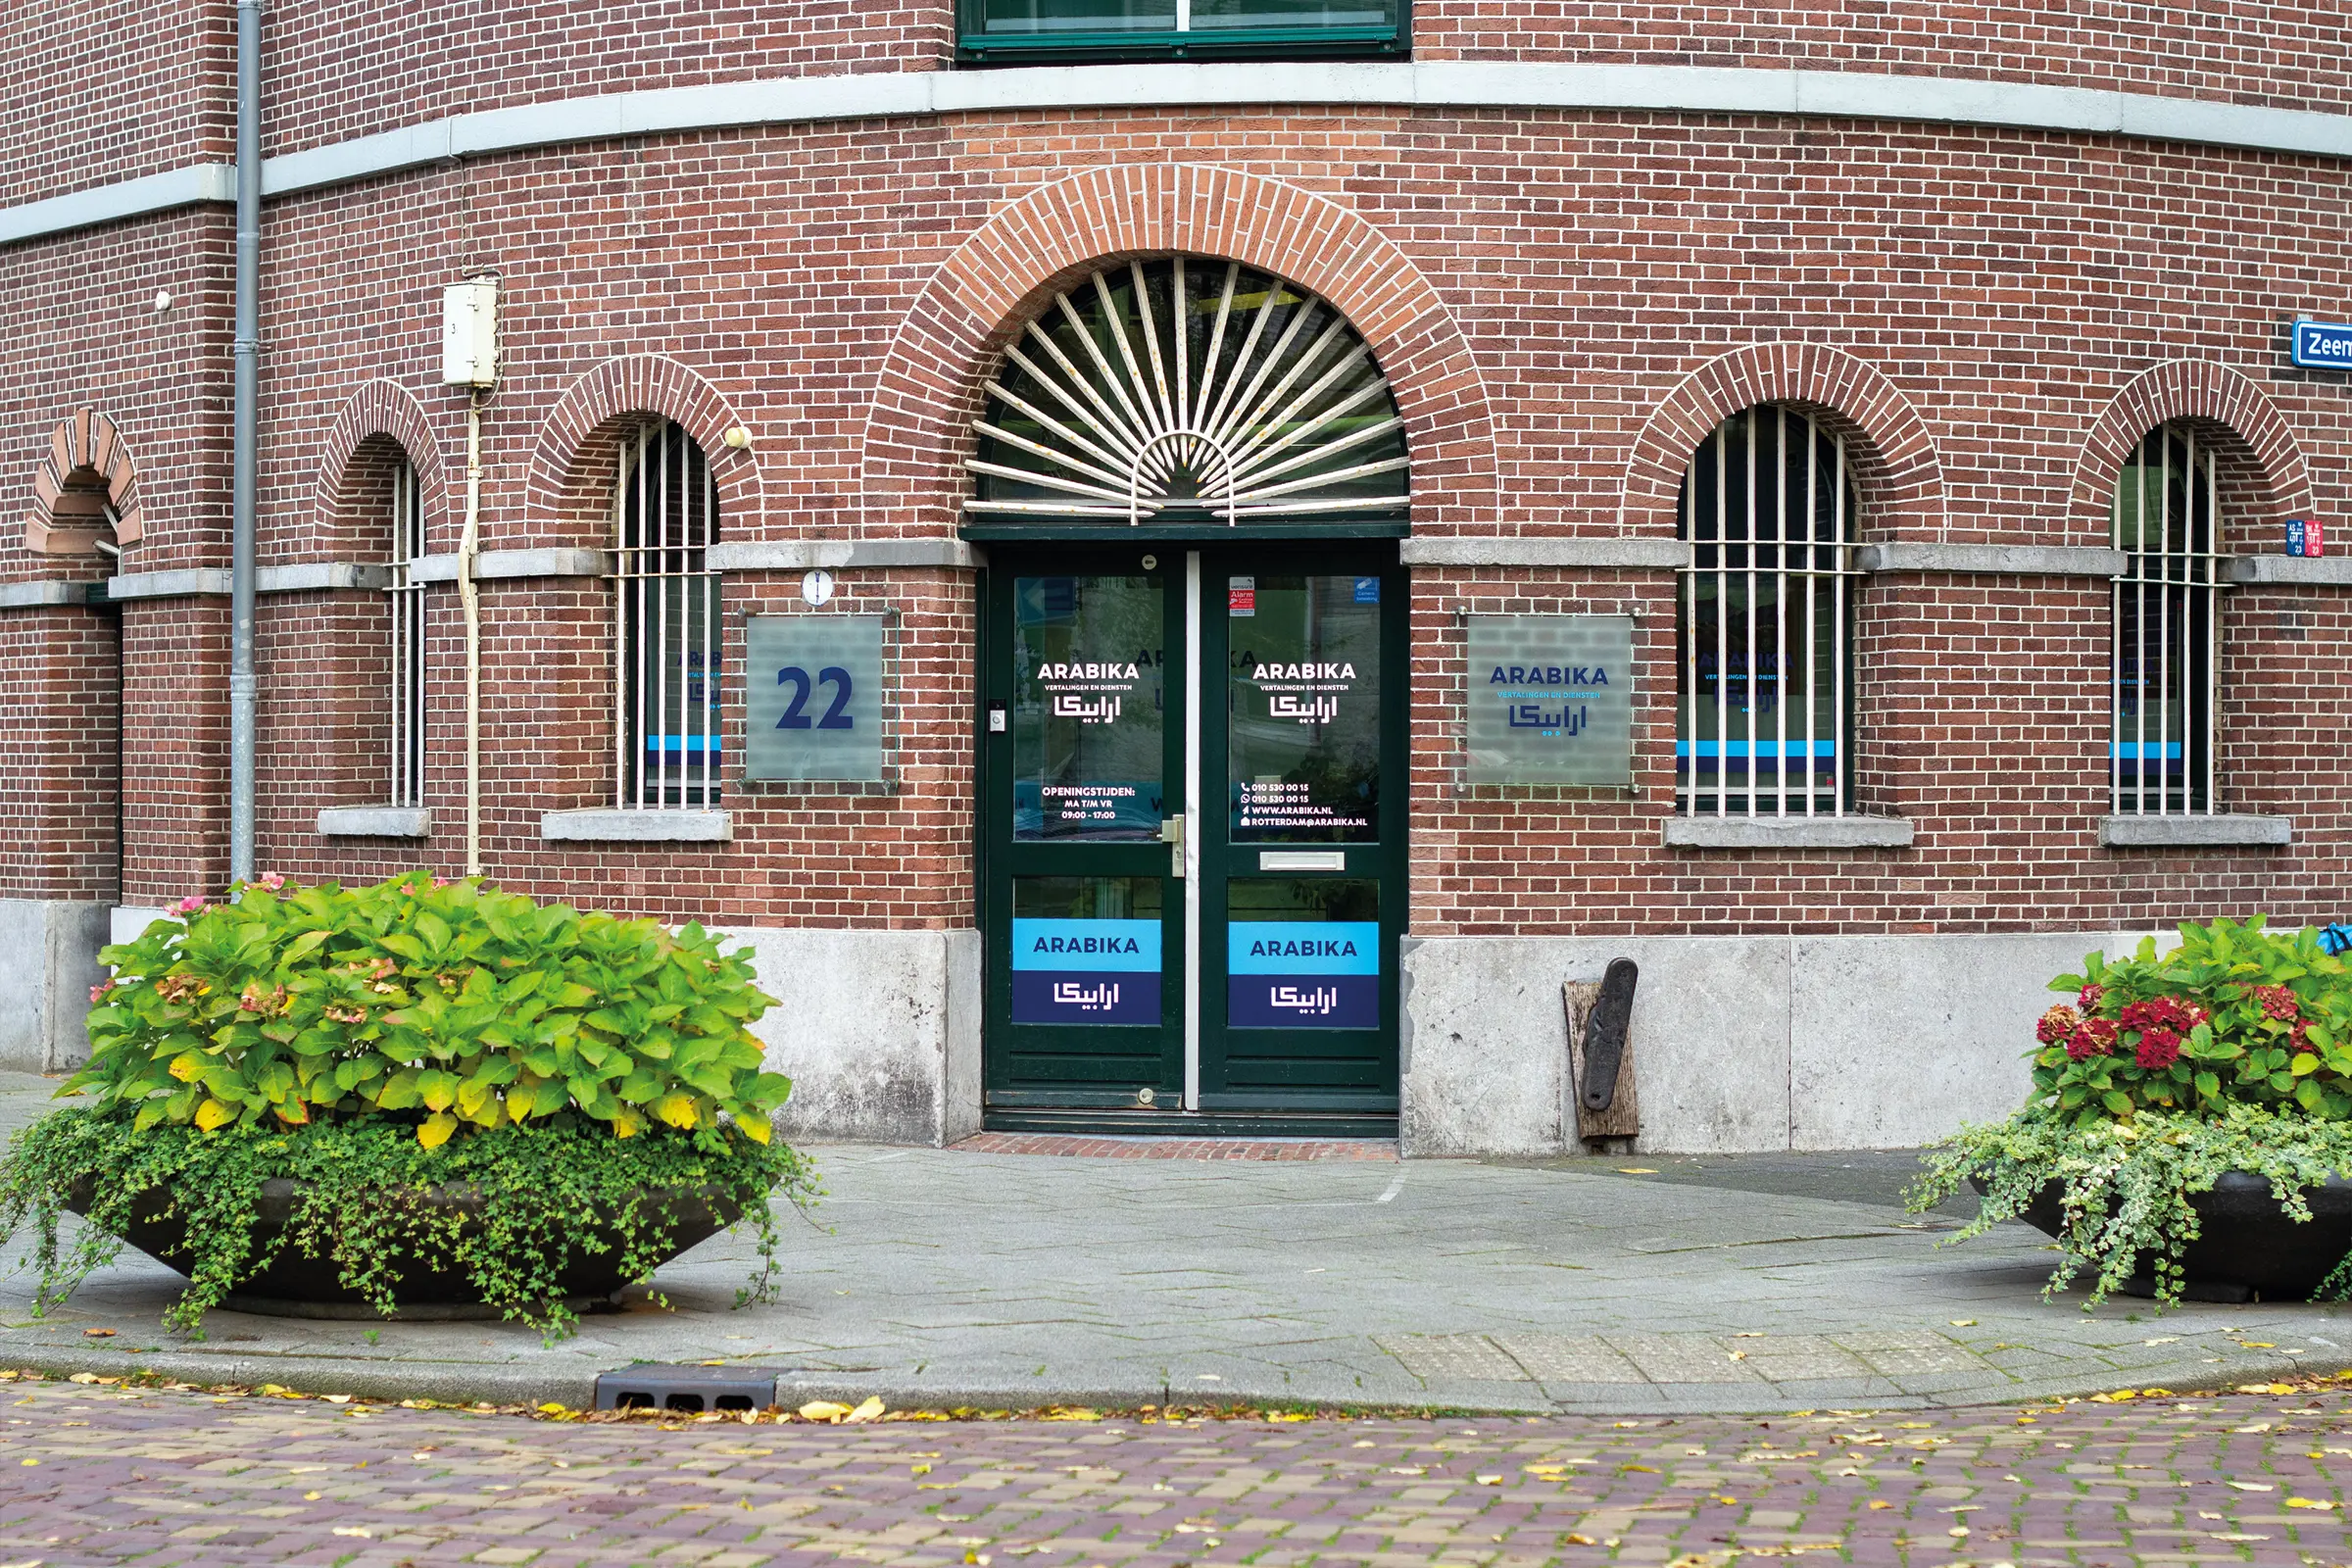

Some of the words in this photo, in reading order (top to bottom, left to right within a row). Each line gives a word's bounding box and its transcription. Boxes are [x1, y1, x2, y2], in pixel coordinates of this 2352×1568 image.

[1037, 662, 1140, 679] ARABIKA
[1252, 662, 1356, 679] ARABIKA
[1490, 666, 1609, 685] ARABIKA
[775, 666, 854, 729] 22
[1042, 787, 1136, 797] OPENINGSTIJDEN:
[1061, 810, 1087, 819] 09:00
[1093, 810, 1116, 819] 17:00
[1251, 818, 1368, 827] ROTTERDAM@ARABIKA.NL
[1033, 937, 1140, 954] ARABIKA
[1250, 940, 1357, 956] ARABIKA
